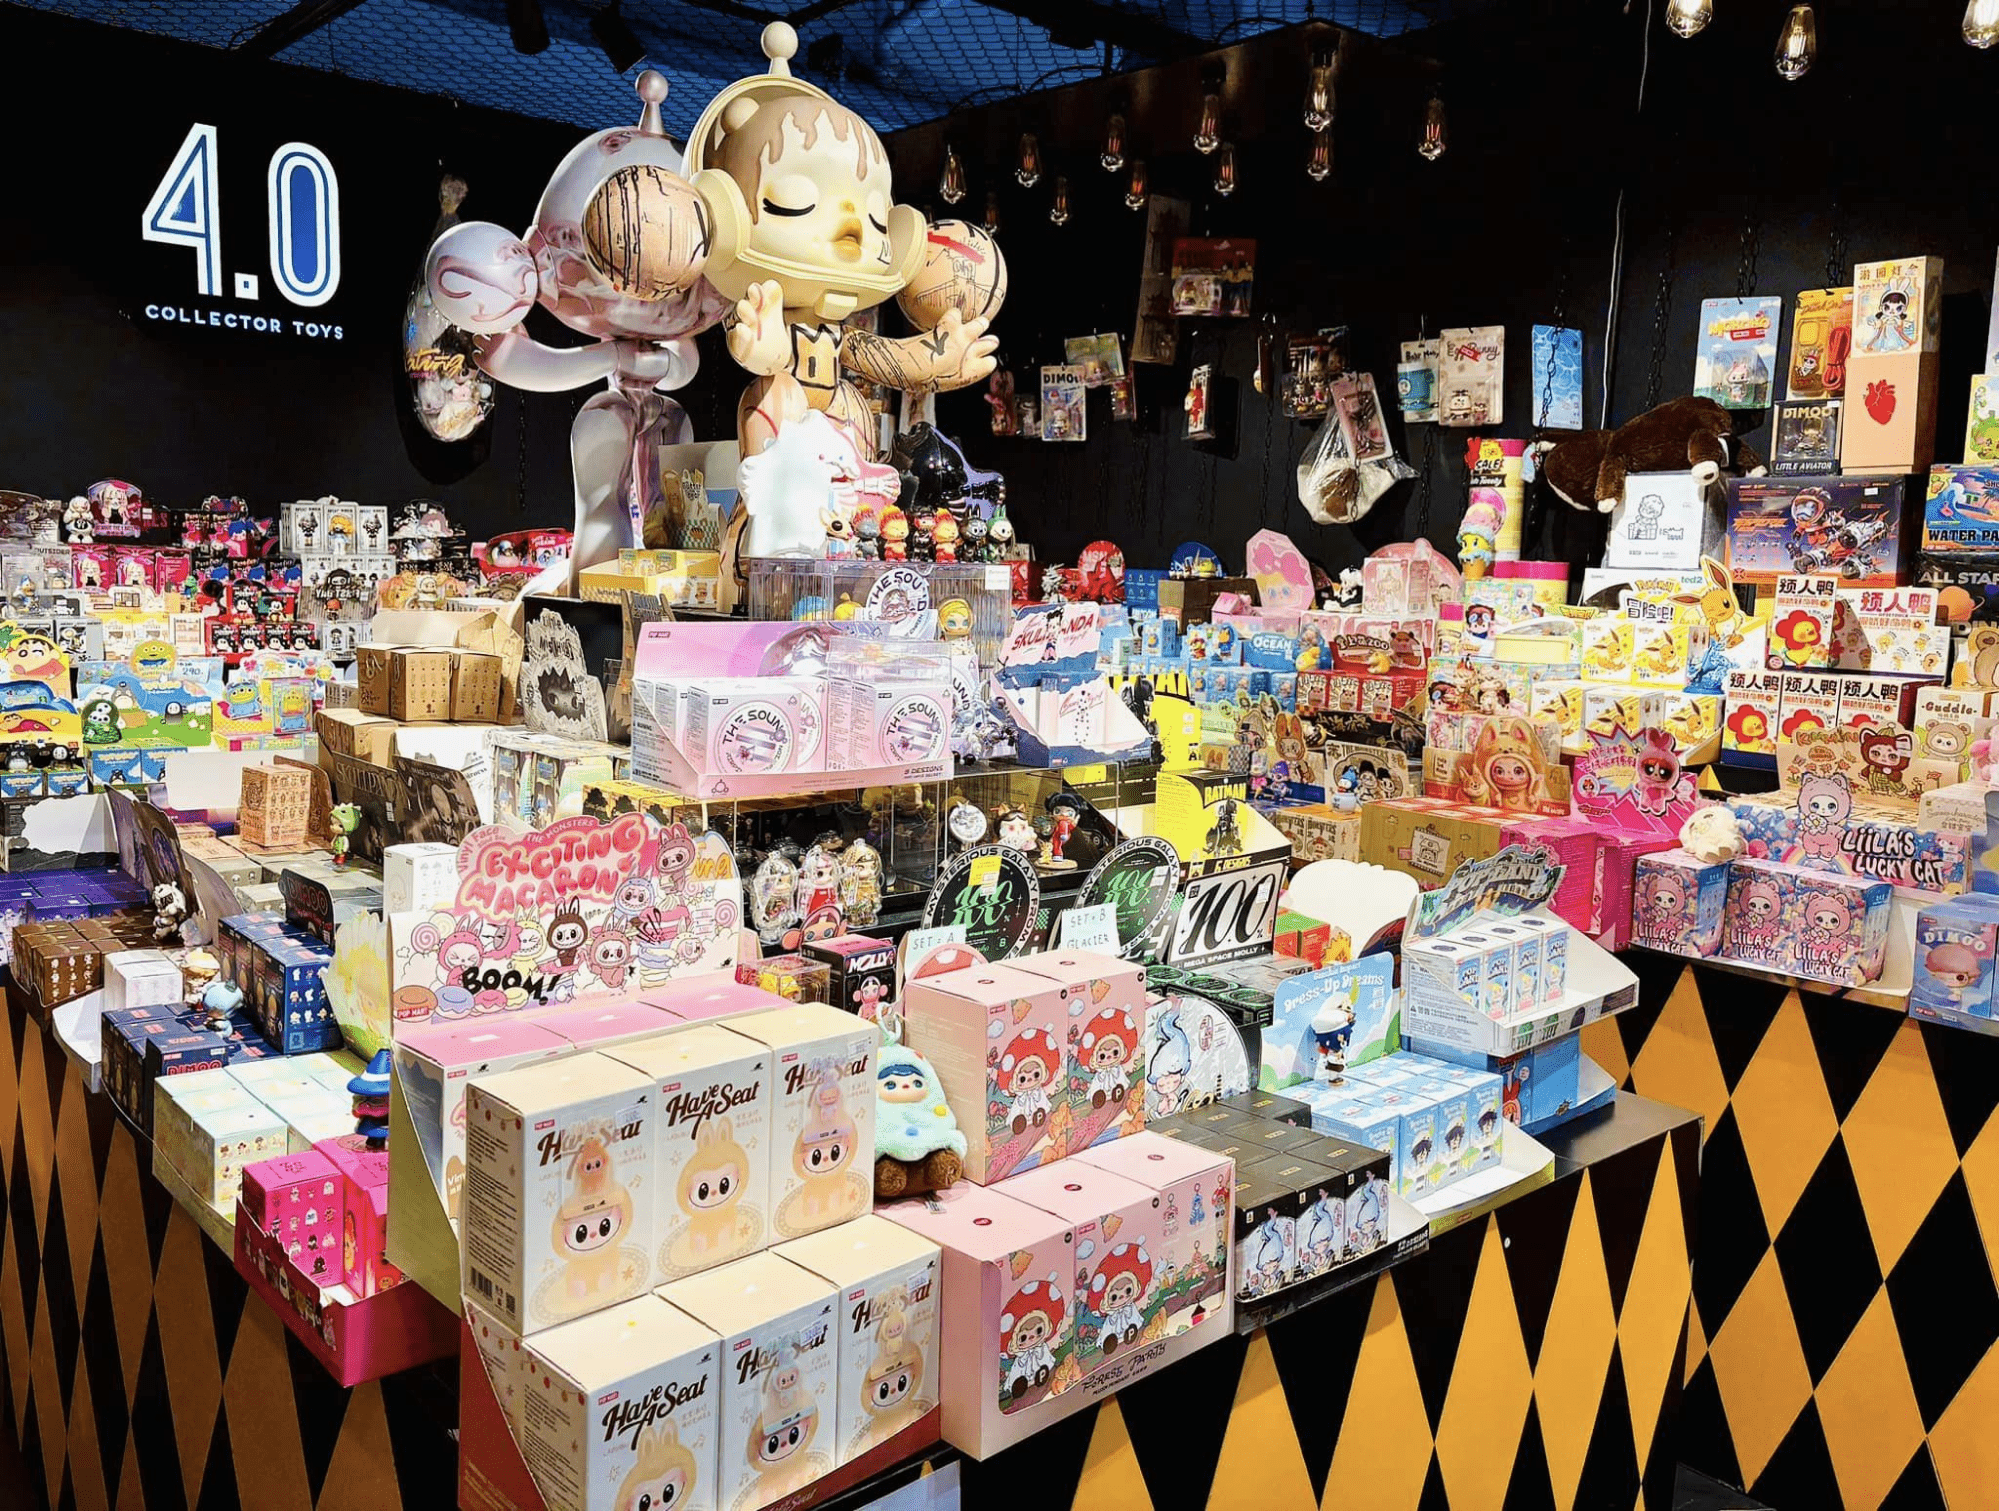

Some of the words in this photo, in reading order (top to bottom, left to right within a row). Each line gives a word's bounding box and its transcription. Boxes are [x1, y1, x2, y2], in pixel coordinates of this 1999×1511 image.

[142, 122, 341, 307] 4.0
[145, 304, 282, 334] COLLECTOR
[292, 321, 344, 340] TOYS
[1782, 406, 1834, 419] DIMOO
[1775, 461, 1798, 471] LITTLE
[1799, 461, 1832, 470] AVIATOR
[1929, 529, 1976, 541] WATER
[893, 571, 928, 612] SOUD
[1919, 571, 1955, 584] ALL
[1204, 782, 1247, 805] BATMAN
[927, 847, 998, 917] MYSTERIOUS
[1001, 849, 1038, 893] GALAXY
[1081, 838, 1152, 899] MYSTERIOUS
[1153, 838, 1179, 878] GALAXY
[1852, 853, 1907, 881] LUCKY
[1910, 859, 1945, 886] CAT
[464, 863, 619, 915] MACARON
[1178, 872, 1276, 956] 100
[848, 950, 890, 974] MOLLY
[1183, 957, 1207, 969] MEGA
[1207, 952, 1233, 964] SPACE
[1234, 946, 1259, 959] MOLLY
[461, 966, 562, 1006] BOOM!
[665, 1083, 720, 1128] Have
[713, 1080, 761, 1116] Seat
[601, 1384, 664, 1443] Have
[656, 1373, 709, 1419] Seat
